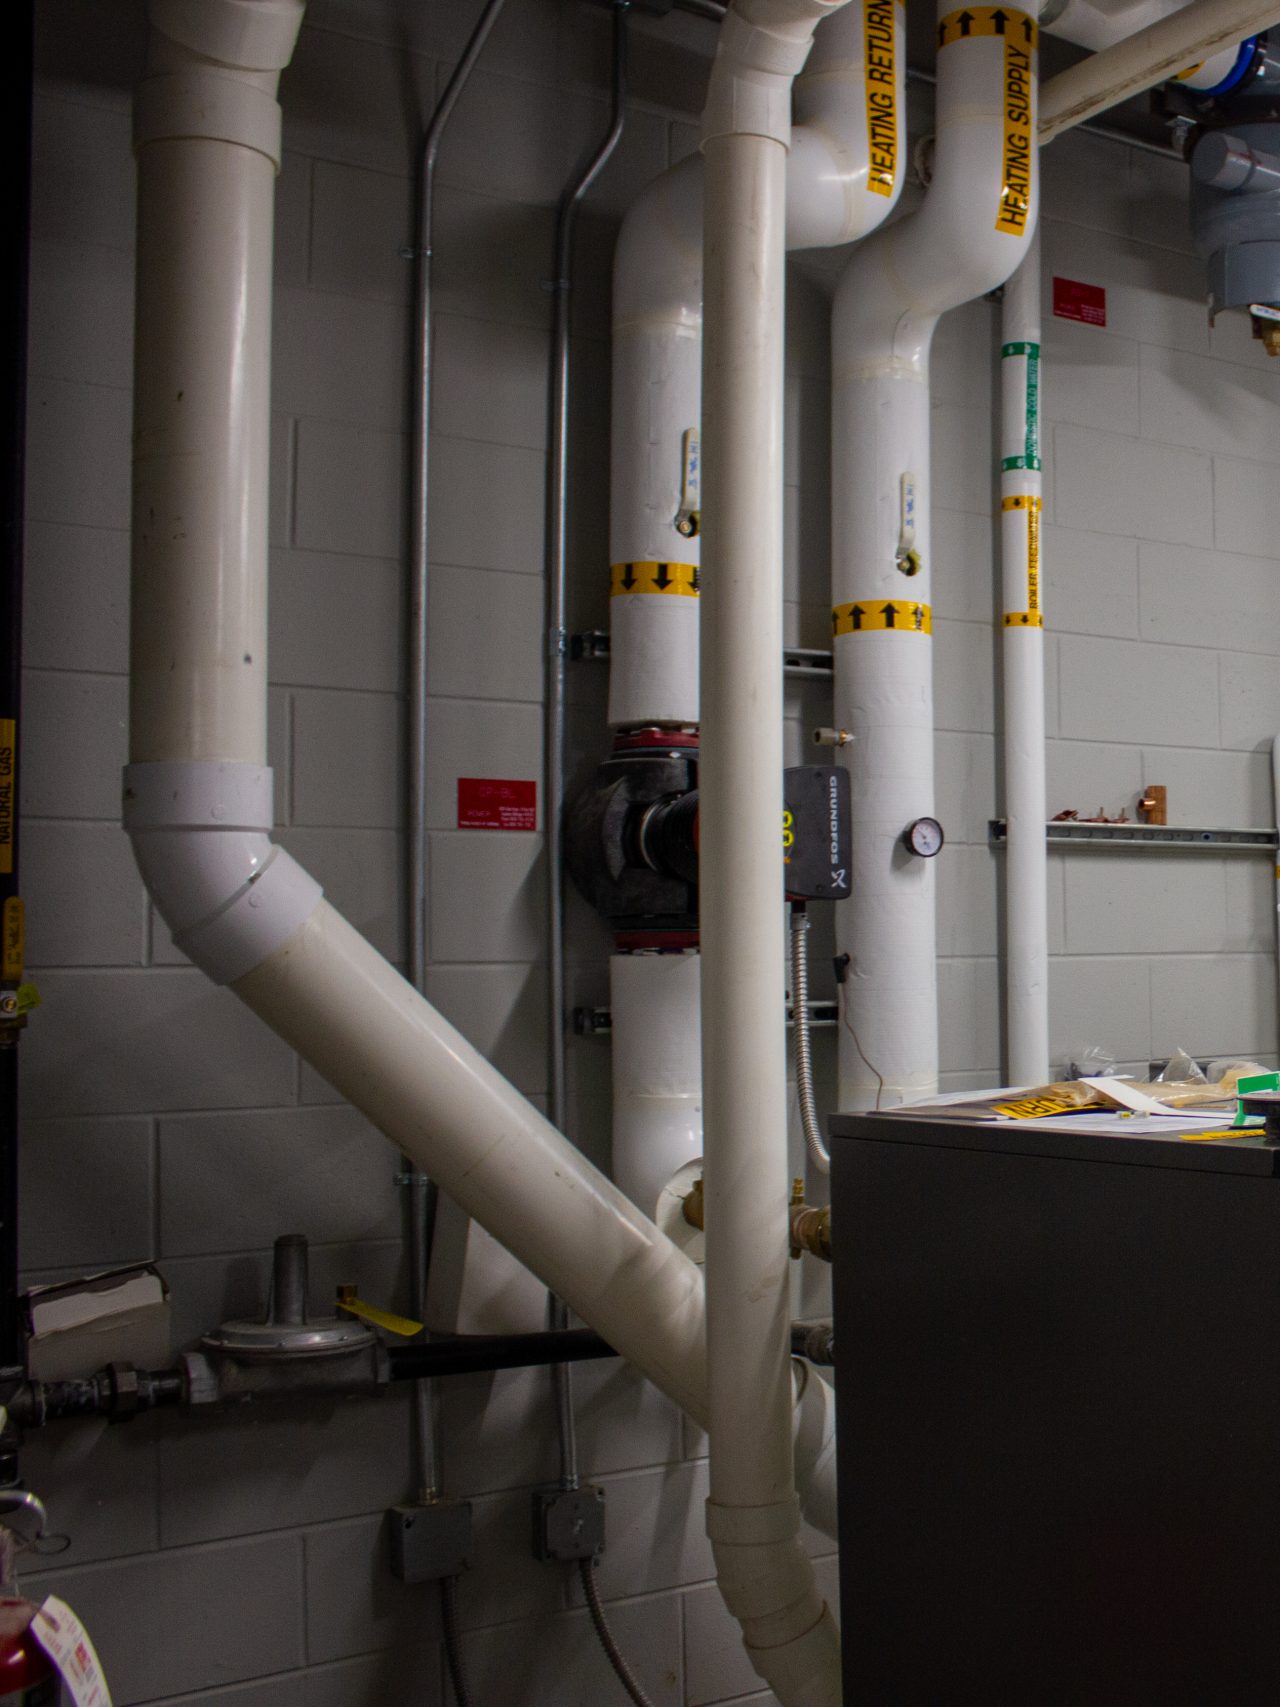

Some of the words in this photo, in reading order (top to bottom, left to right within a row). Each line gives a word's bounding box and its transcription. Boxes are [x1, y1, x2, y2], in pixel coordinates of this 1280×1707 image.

[865, 0, 894, 85] RETURN
[1007, 45, 1031, 125] SUPPLY
[867, 92, 895, 187] HEATING
[1001, 133, 1029, 226] HEATING
[1026, 388, 1038, 410] COLD
[1027, 359, 1038, 384] WATER
[1028, 573, 1038, 609] BOILER
[1, 746, 13, 776] GAS
[829, 775, 839, 865] GRUNDFOS
